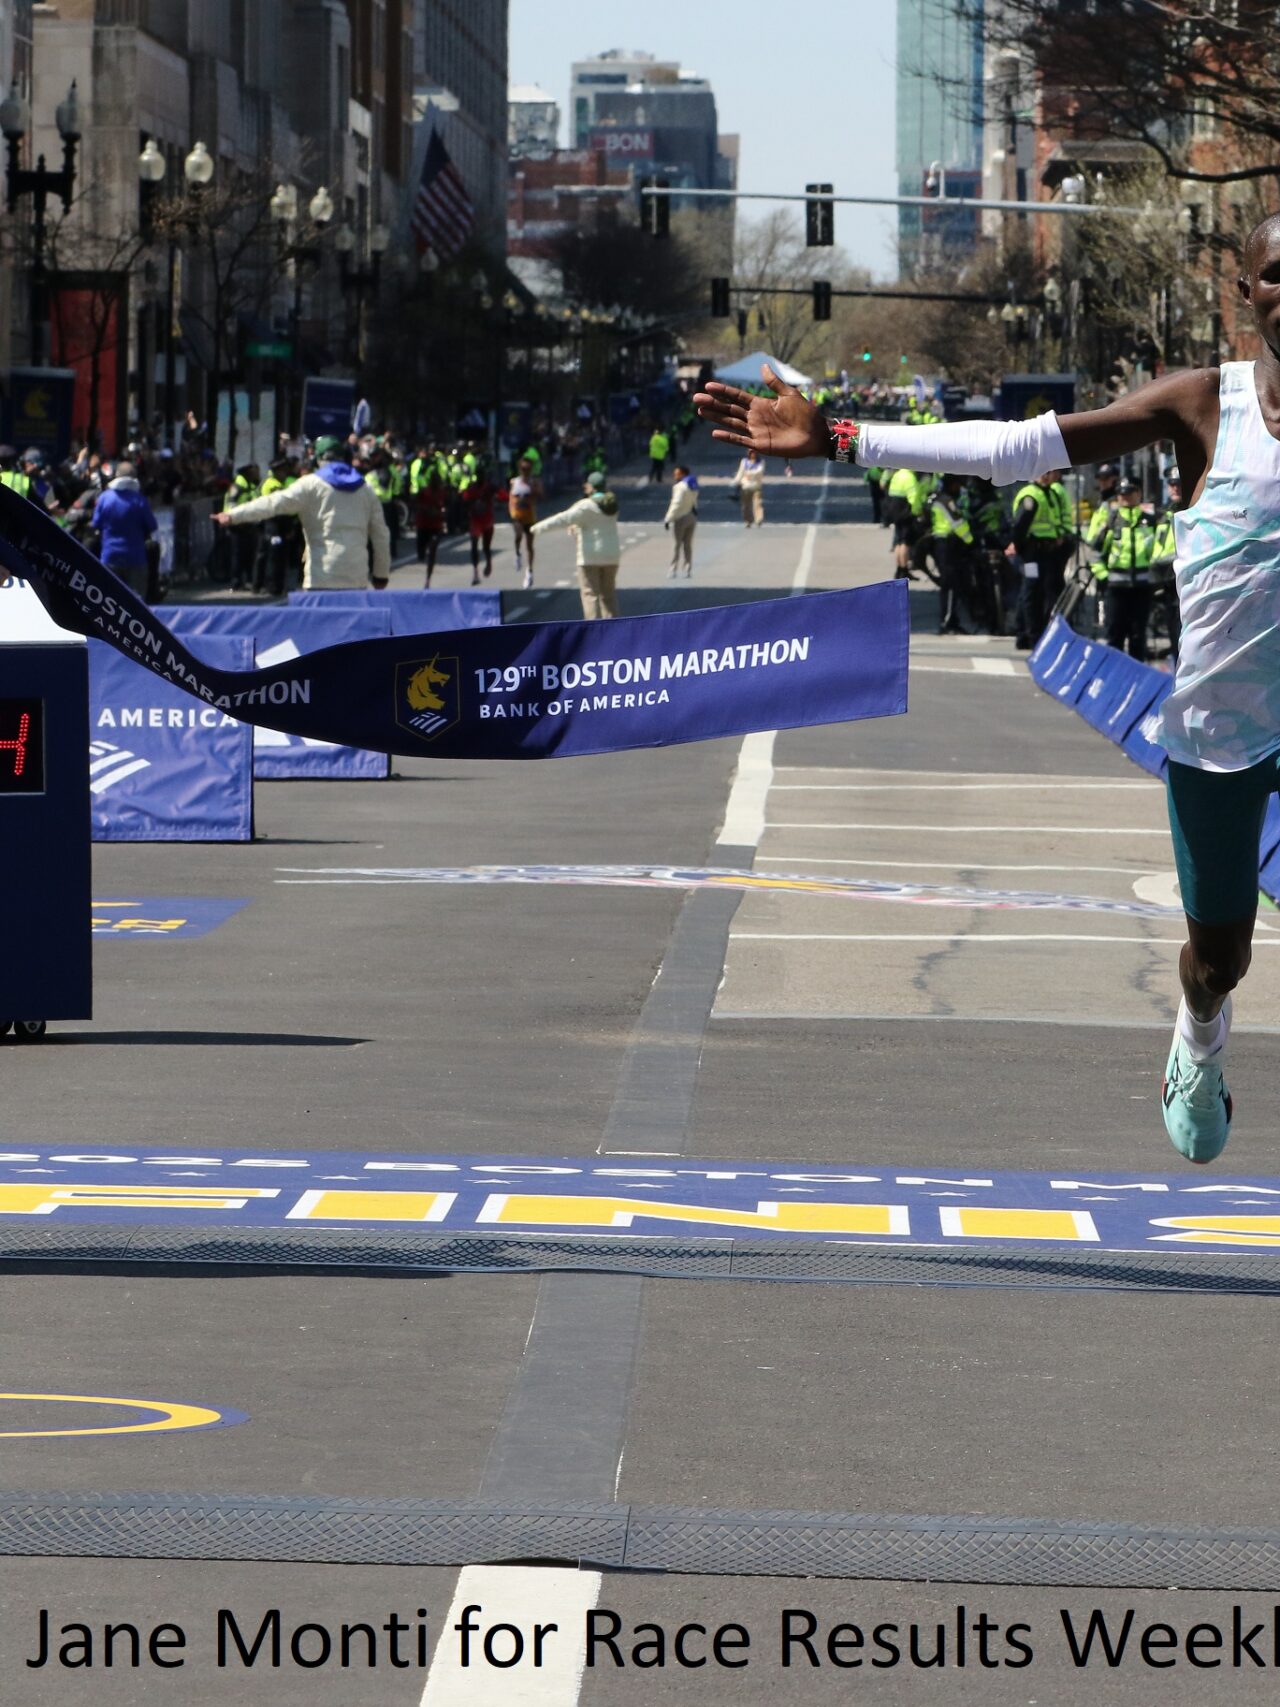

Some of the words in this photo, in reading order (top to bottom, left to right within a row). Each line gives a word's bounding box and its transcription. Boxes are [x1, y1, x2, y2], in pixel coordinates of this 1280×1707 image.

[68, 568, 162, 655] BOSTON
[165, 652, 311, 709] MARATHON
[94, 615, 174, 682] AMERICA
[474, 664, 537, 693] 129TH
[542, 656, 651, 691] BOSTON
[658, 636, 811, 680] MARATHON
[97, 708, 240, 729] AMERICA
[479, 703, 540, 719] BANK
[546, 699, 574, 716] OF
[579, 689, 671, 713] AMERICA
[363, 1161, 994, 1188] BOSTON
